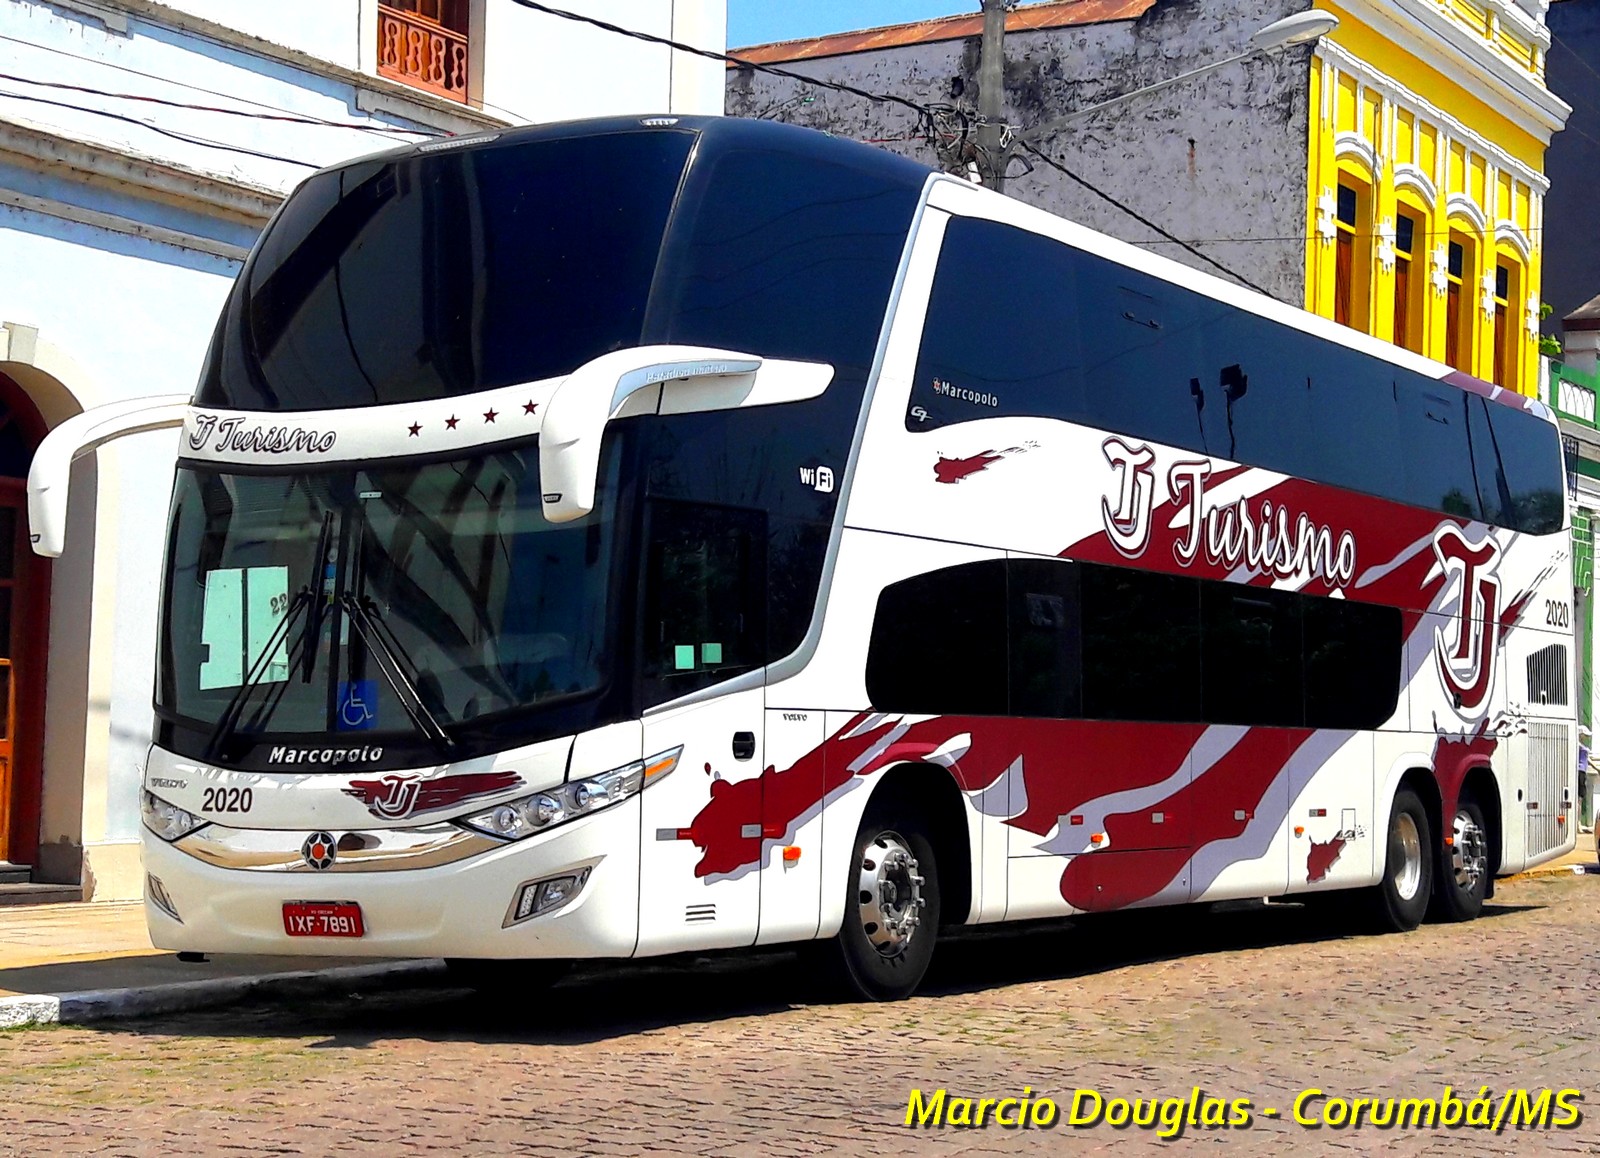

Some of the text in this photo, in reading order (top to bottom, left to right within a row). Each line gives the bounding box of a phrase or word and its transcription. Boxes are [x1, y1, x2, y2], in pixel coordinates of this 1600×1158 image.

[941, 381, 998, 407] Marcopolo
[217, 416, 337, 453] Turismo
[1167, 459, 1356, 587] Turismo
[1545, 599, 1569, 628] 2020
[268, 745, 383, 765] Marcopolo
[201, 787, 253, 813] 2020
